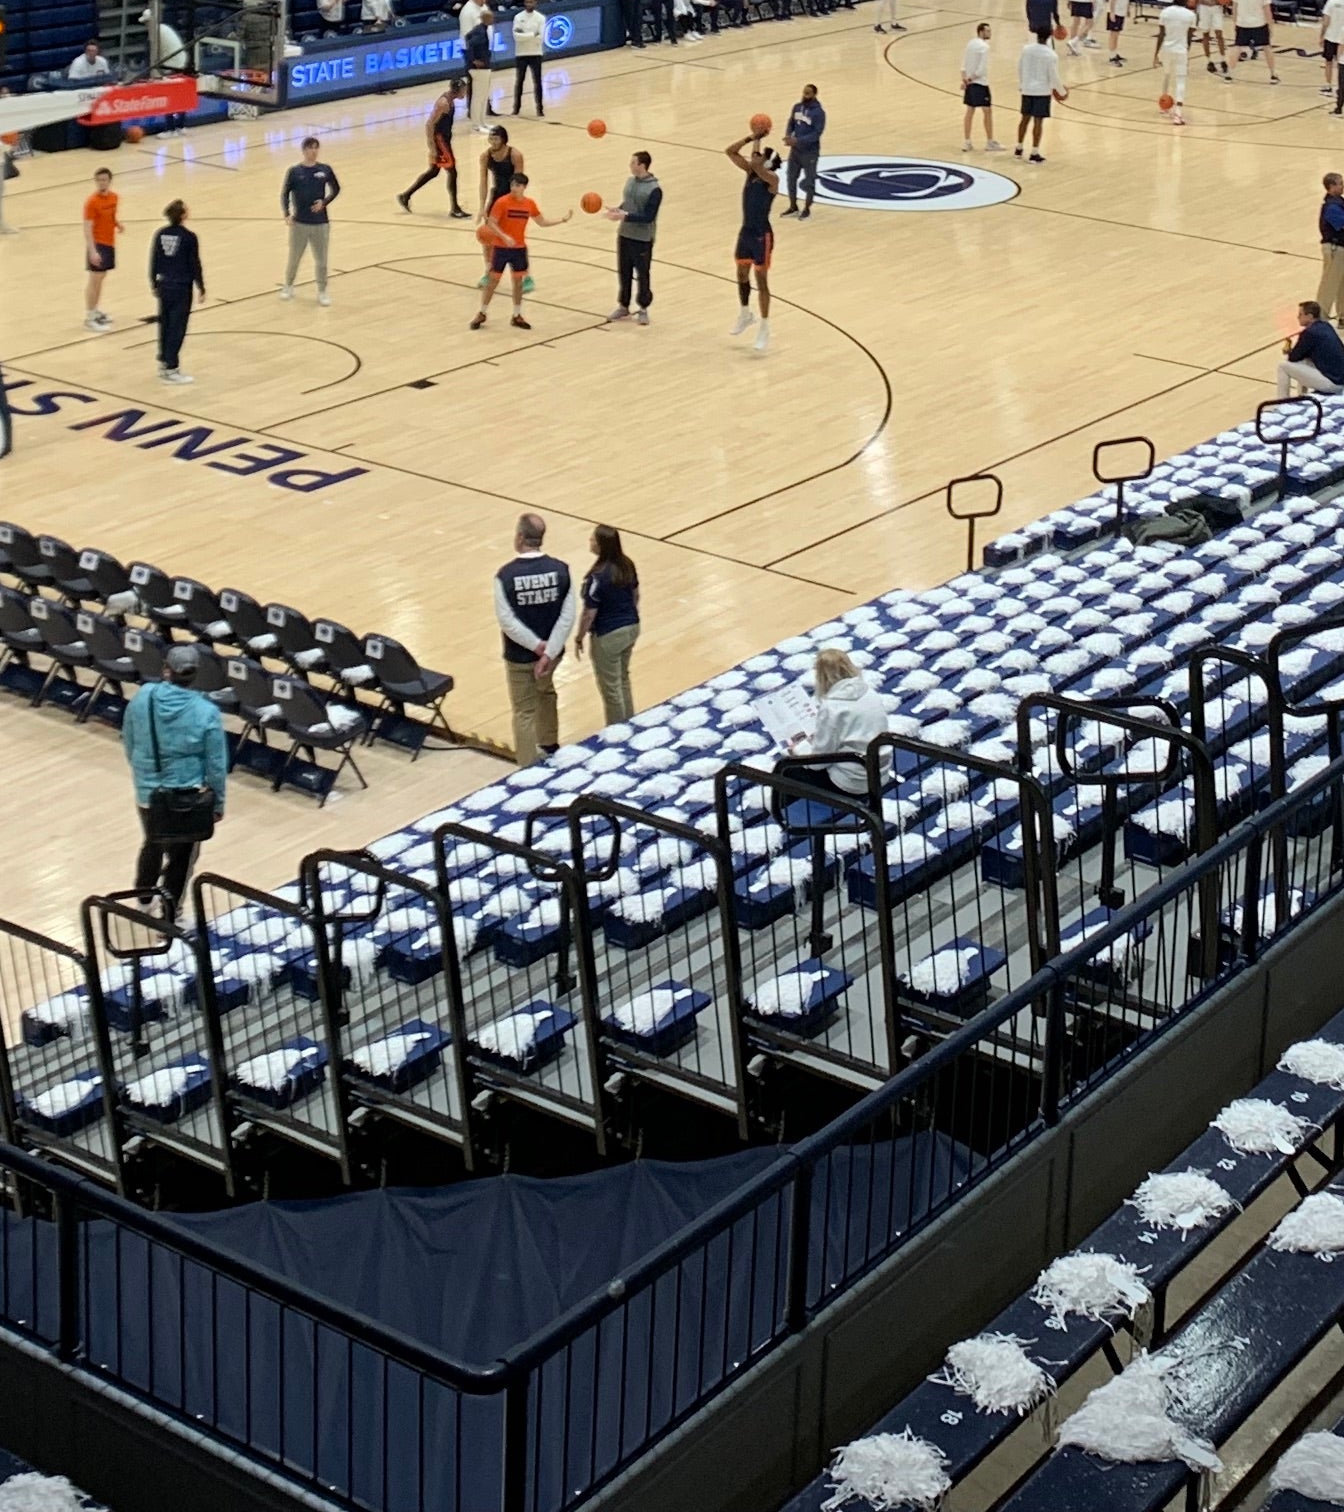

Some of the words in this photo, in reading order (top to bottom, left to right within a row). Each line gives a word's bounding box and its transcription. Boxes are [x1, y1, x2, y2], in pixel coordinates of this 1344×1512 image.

[292, 57, 353, 87] STATE
[68, 407, 370, 493] PENN
[514, 572, 558, 591] EVENT
[517, 590, 558, 606] STAFF
[940, 1410, 963, 1426] 18
